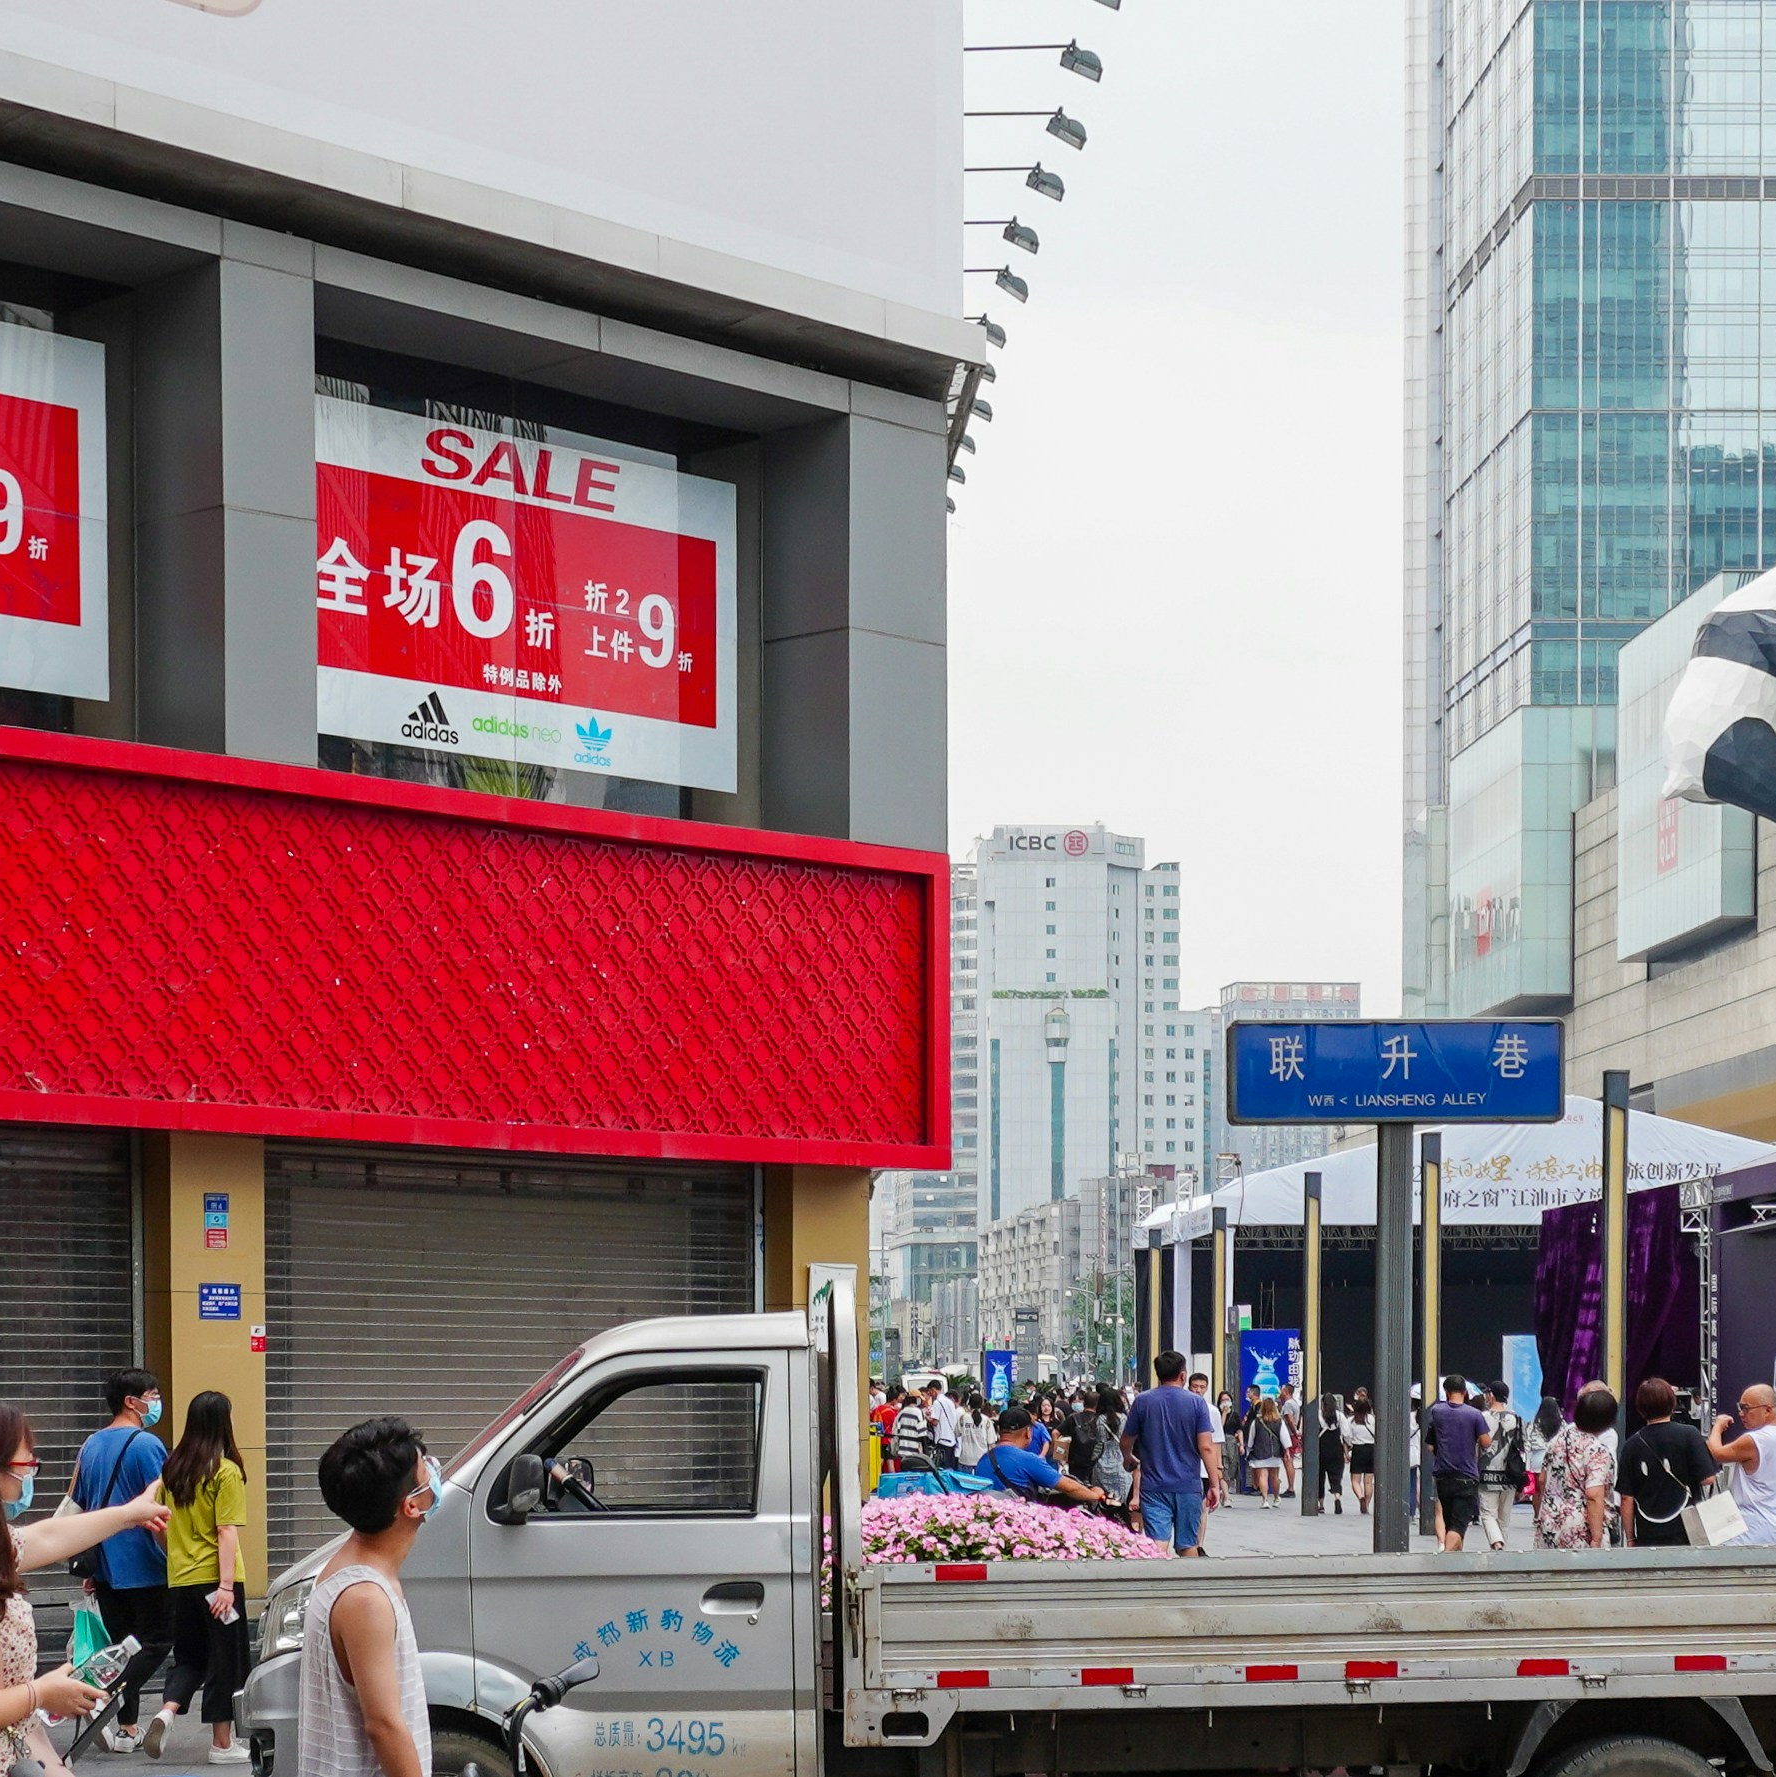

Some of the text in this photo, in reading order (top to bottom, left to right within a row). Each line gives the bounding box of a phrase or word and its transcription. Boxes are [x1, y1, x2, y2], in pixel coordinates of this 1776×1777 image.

[420, 428, 621, 514] SALE
[483, 663, 563, 695] 特例品除外
[401, 721, 460, 746] adidas
[471, 716, 562, 744] adidas neo
[573, 751, 612, 767] adidas
[1009, 835, 1056, 851] ICBC
[1269, 1033, 1530, 1082] 联升巷
[1355, 1093, 1436, 1108] LIANSHENG
[1442, 1092, 1488, 1106] ALLEY
[645, 1717, 726, 1757] 3495
